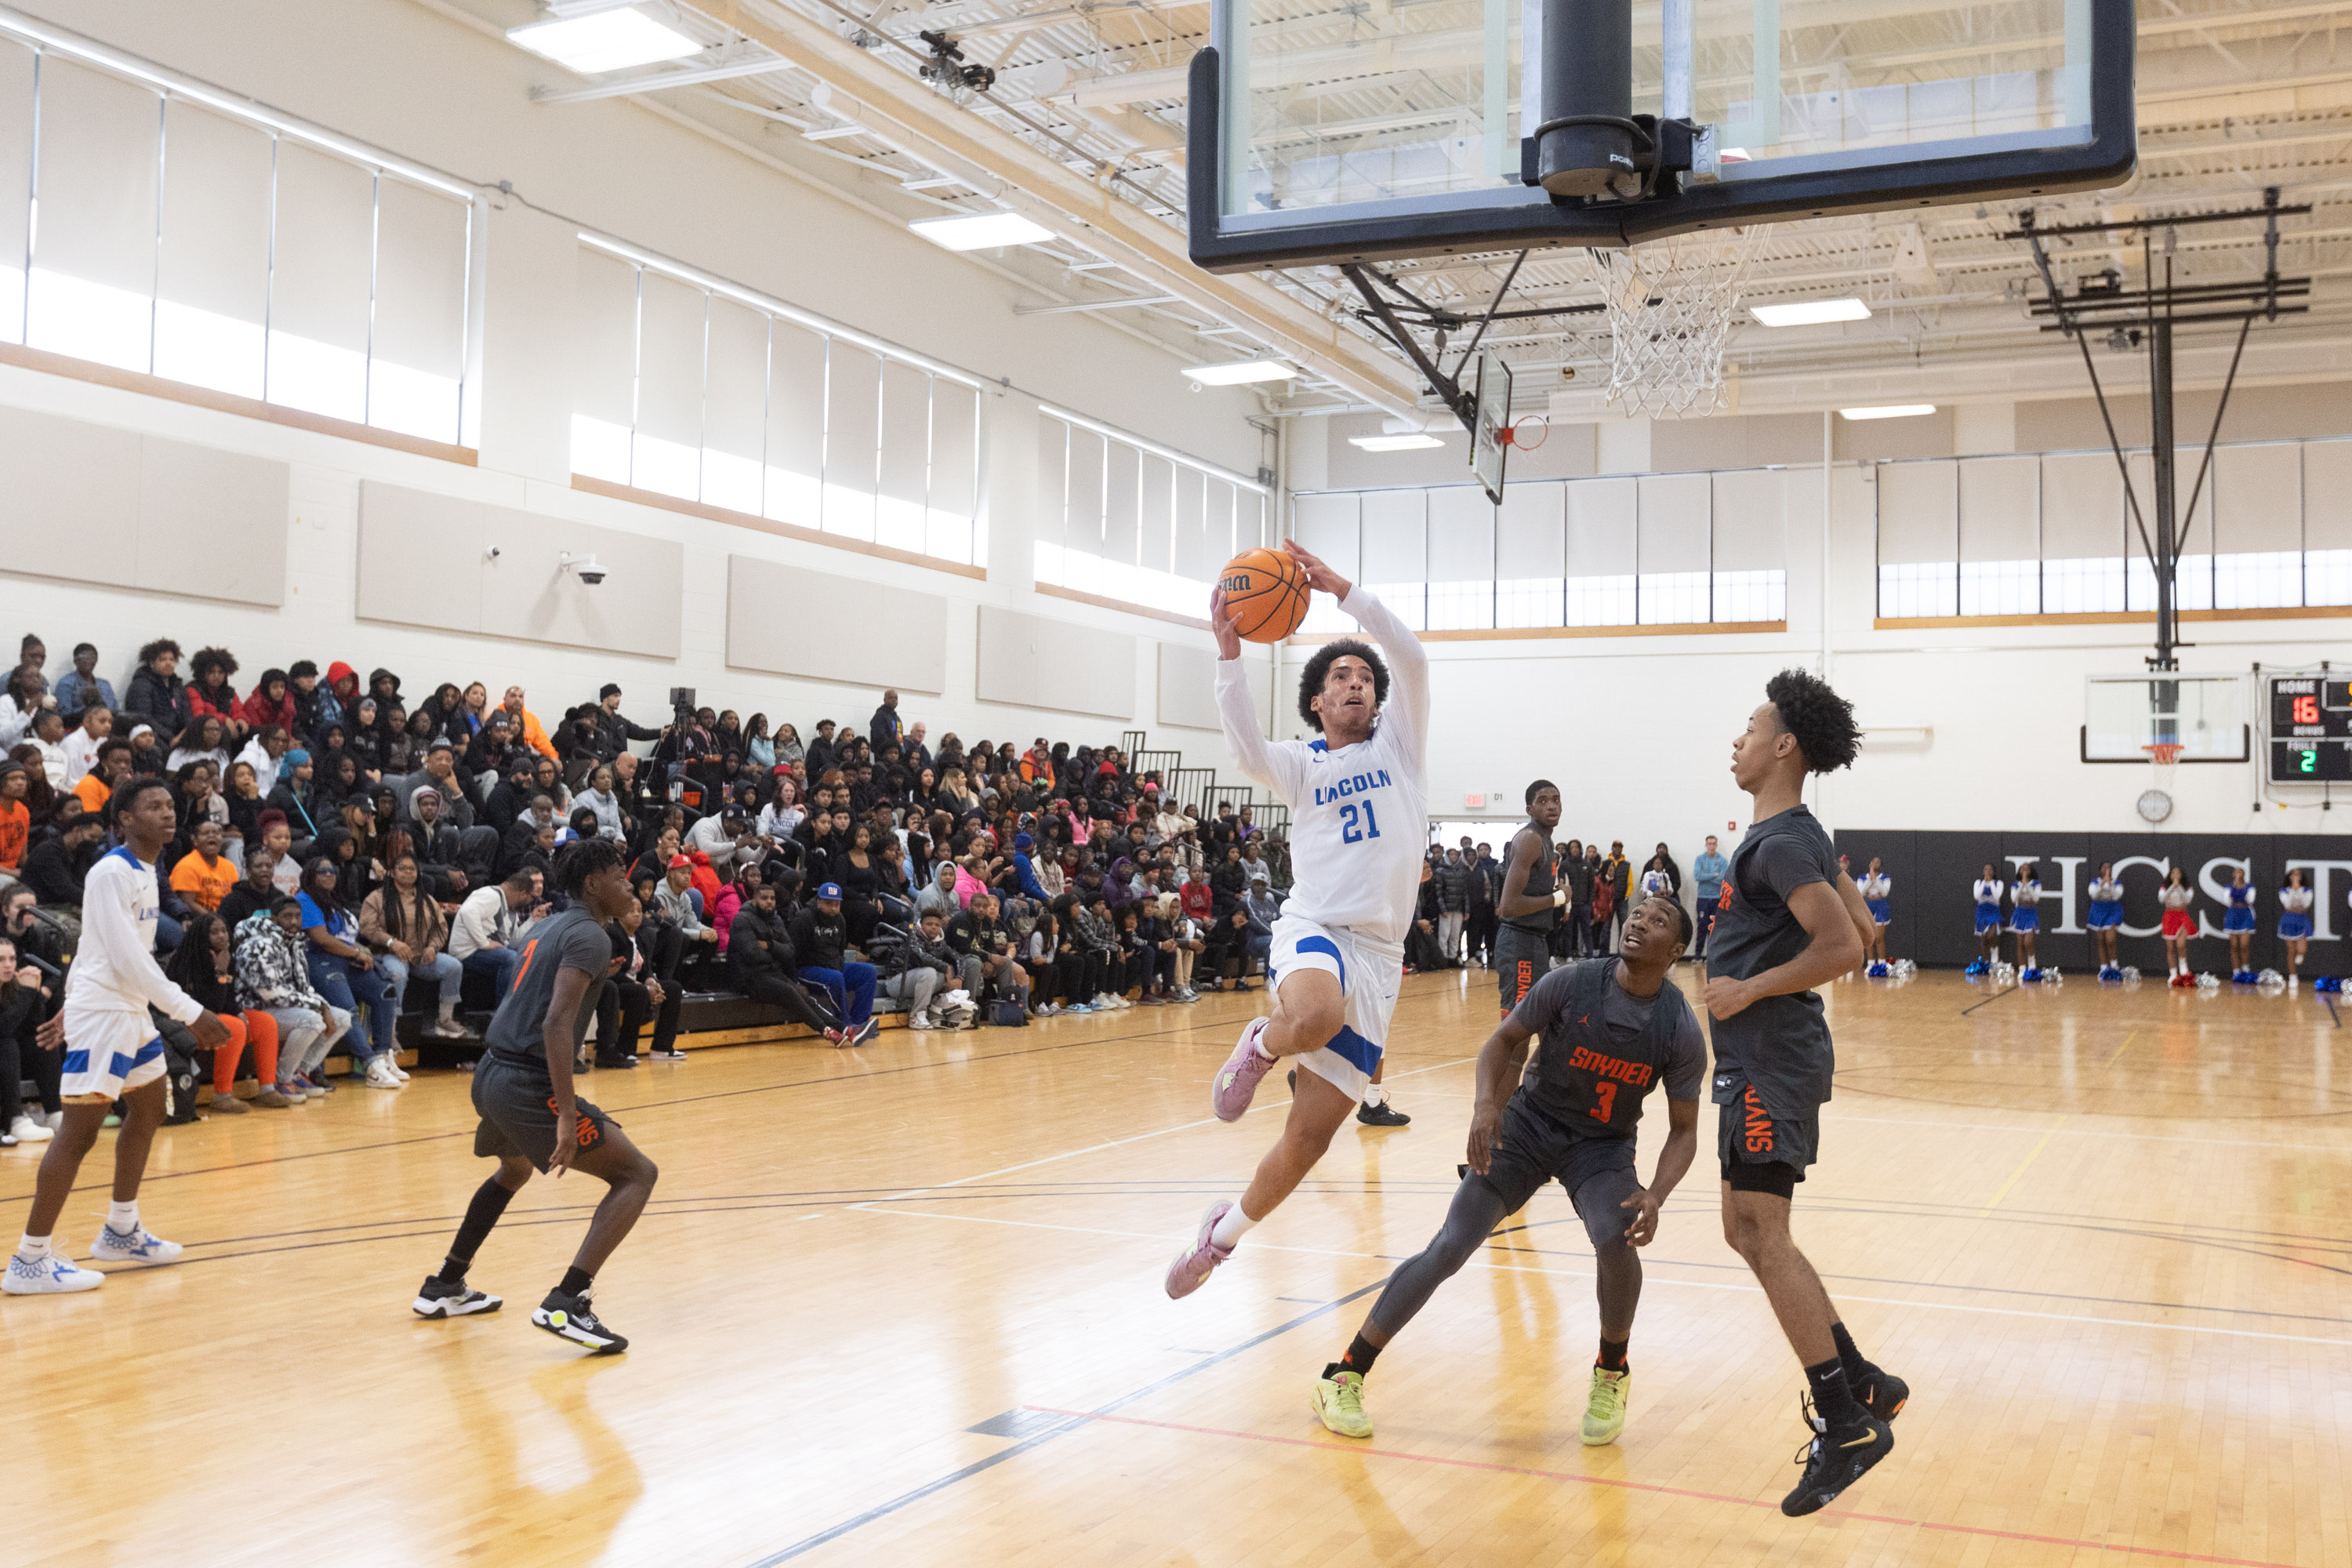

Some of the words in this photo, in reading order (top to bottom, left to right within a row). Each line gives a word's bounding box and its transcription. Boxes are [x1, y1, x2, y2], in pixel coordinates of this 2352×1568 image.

[2278, 681, 2315, 694] HOME
[2293, 696, 2319, 723] 16
[2301, 750, 2316, 771] 2
[1466, 794, 1483, 806] EXIT
[1339, 800, 1380, 844] 21
[1515, 960, 1532, 1004] NYDER
[1569, 1046, 1653, 1087] SNYDER
[1590, 1081, 1617, 1123] 3
[1744, 1084, 1773, 1152] SNYD
